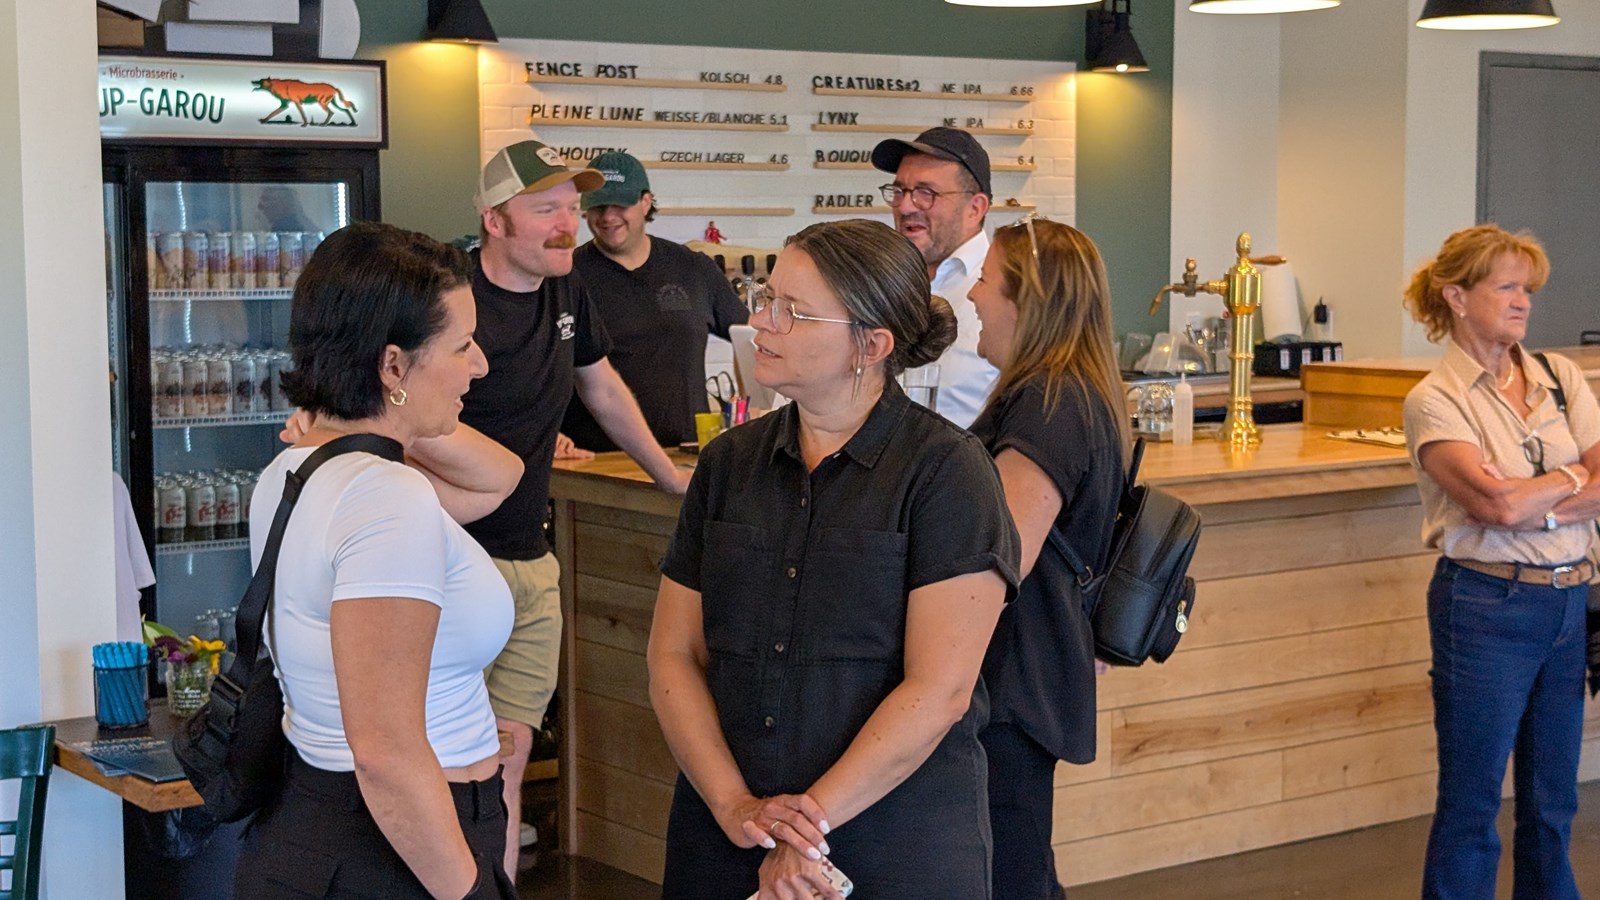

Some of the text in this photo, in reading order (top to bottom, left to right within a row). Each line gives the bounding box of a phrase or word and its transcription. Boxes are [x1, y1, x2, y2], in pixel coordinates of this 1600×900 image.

[109, 66, 178, 80] Microbrasserie
[525, 62, 783, 86] FENCE POST KOLSCH 4.8
[942, 84, 956, 93] NE
[964, 84, 982, 94] IPA
[531, 104, 593, 120] PLEINE
[600, 106, 645, 121] LUNE
[770, 114, 788, 125] 5.1
[818, 112, 859, 125] LYNX
[943, 117, 957, 128] NE
[966, 117, 983, 128] IPA
[660, 151, 702, 163] CZECH
[706, 152, 745, 164] LAGER
[769, 154, 788, 165] 4.6
[815, 194, 874, 208] RADLER
